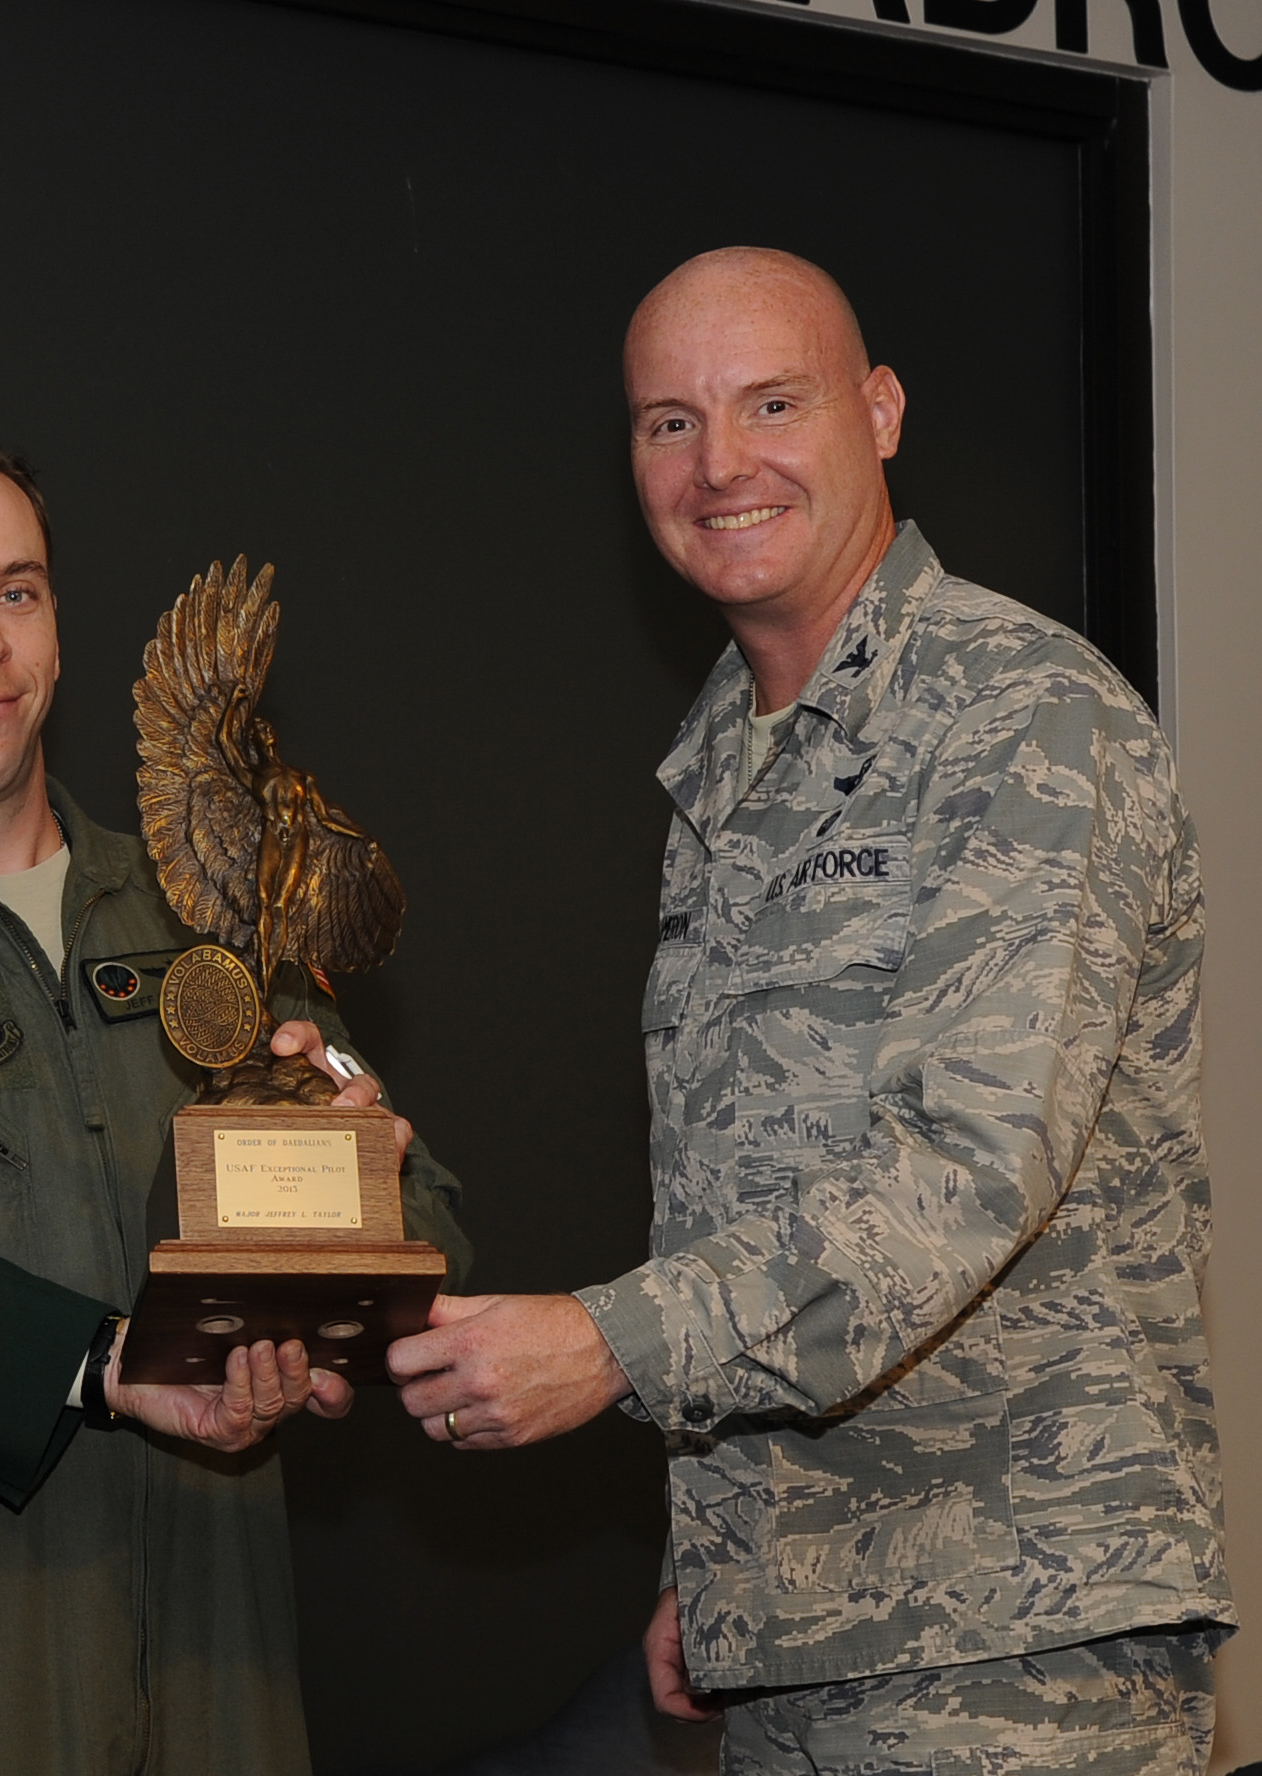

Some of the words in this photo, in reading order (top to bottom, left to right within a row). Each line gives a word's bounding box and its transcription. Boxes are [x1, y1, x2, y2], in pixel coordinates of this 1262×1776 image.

[812, 848, 889, 882] FORCE
[168, 949, 248, 989] VOLABAMUS
[125, 994, 154, 1010] JEFF
[179, 1036, 246, 1063] VOLAMUS
[236, 1139, 262, 1147] ORDER
[267, 1139, 276, 1147] OF
[282, 1139, 332, 1147] DAEDALIANS
[226, 1164, 256, 1173] USAF
